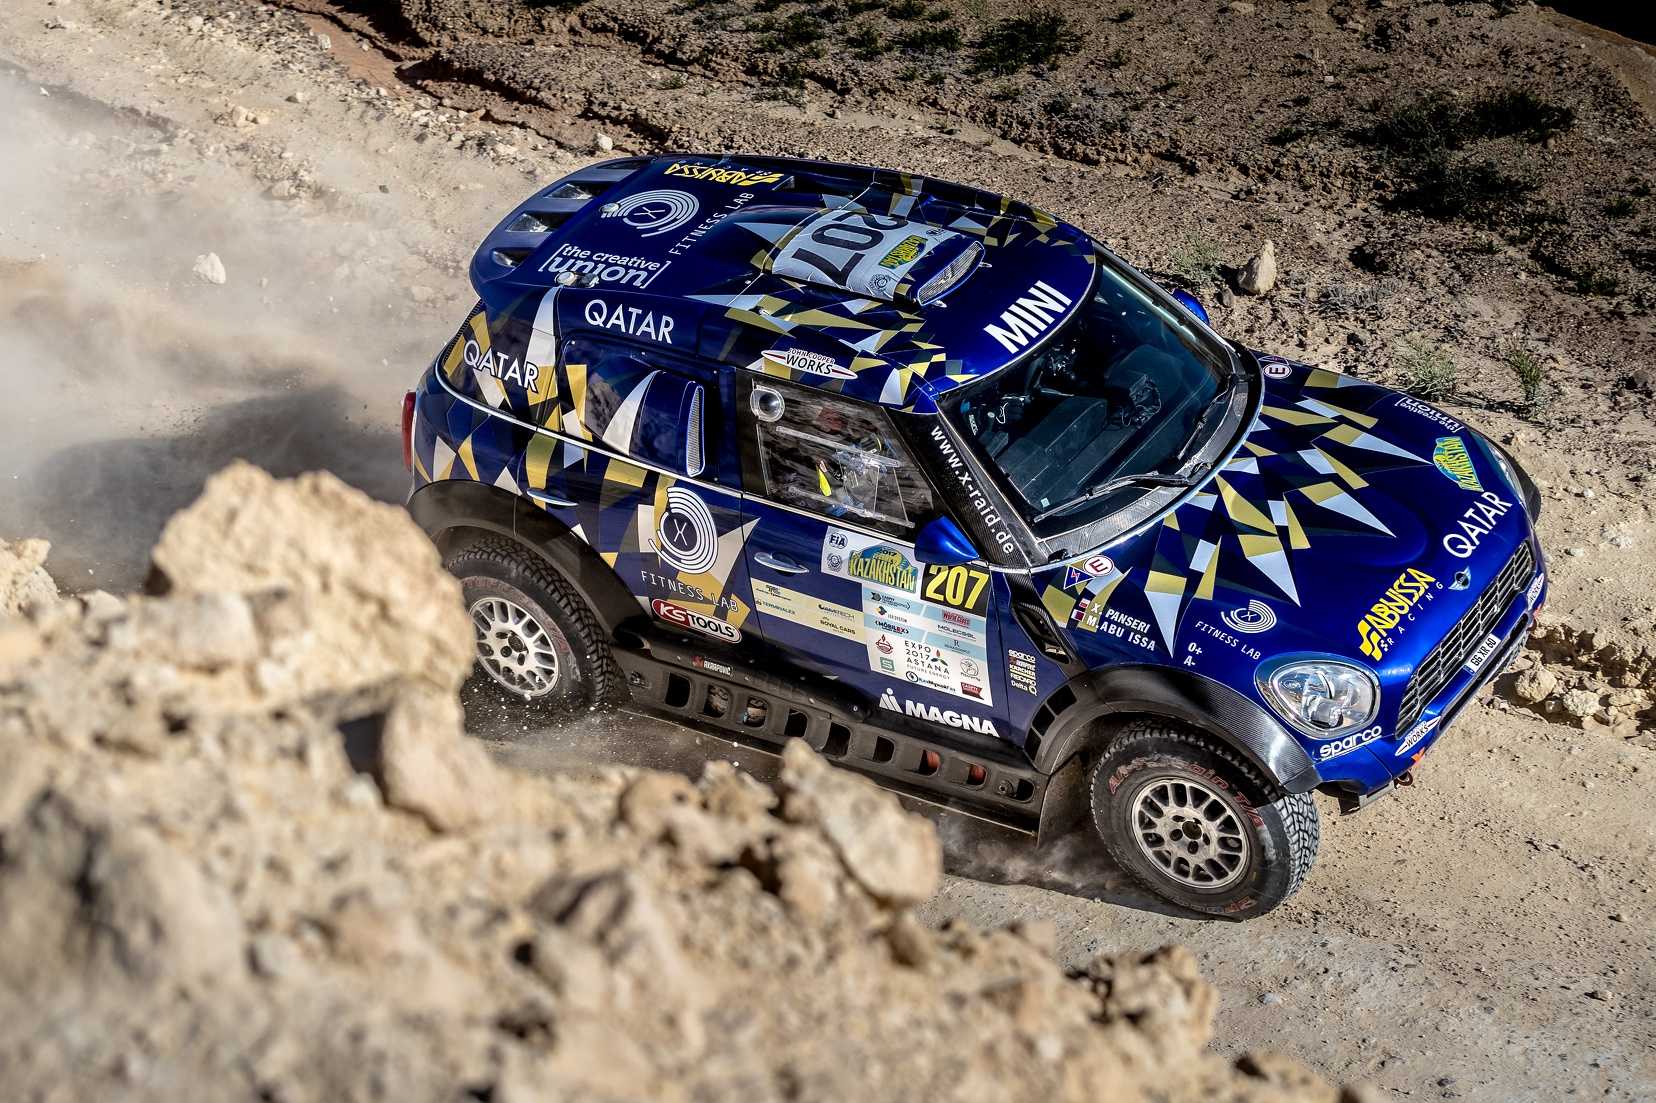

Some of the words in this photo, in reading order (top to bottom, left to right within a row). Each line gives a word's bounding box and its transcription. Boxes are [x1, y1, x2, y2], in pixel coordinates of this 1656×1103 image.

[668, 212, 728, 256] FITNESS
[725, 192, 754, 210] LAB
[548, 256, 650, 288] union
[563, 244, 590, 259] the
[593, 251, 661, 272] creative
[585, 300, 675, 345] QATAR
[984, 280, 1073, 354] MINI
[463, 340, 539, 393] QATAR
[785, 355, 833, 376] WORKS
[787, 347, 809, 359] JOHN
[809, 352, 836, 365] COOPER
[930, 425, 1014, 554] www.x-raid.de
[1443, 491, 1513, 559] QATAR
[641, 570, 704, 601] FITNESS
[710, 593, 739, 612] LAB
[849, 556, 915, 591] KAZAKHSTAN
[925, 564, 990, 610] 207
[1105, 608, 1150, 634] PANSERI
[1387, 582, 1444, 646] RACING
[904, 640, 932, 654] EXPO
[1100, 621, 1124, 640] ABU
[1128, 632, 1156, 652] ISSA
[1195, 620, 1240, 648] FITNESS
[1240, 644, 1261, 661] LAB
[1480, 644, 1491, 659] XR
[906, 649, 931, 661] 2017
[906, 657, 951, 676] ASTANA
[905, 700, 1000, 738] MAGNA
[1320, 725, 1382, 757] sparco
